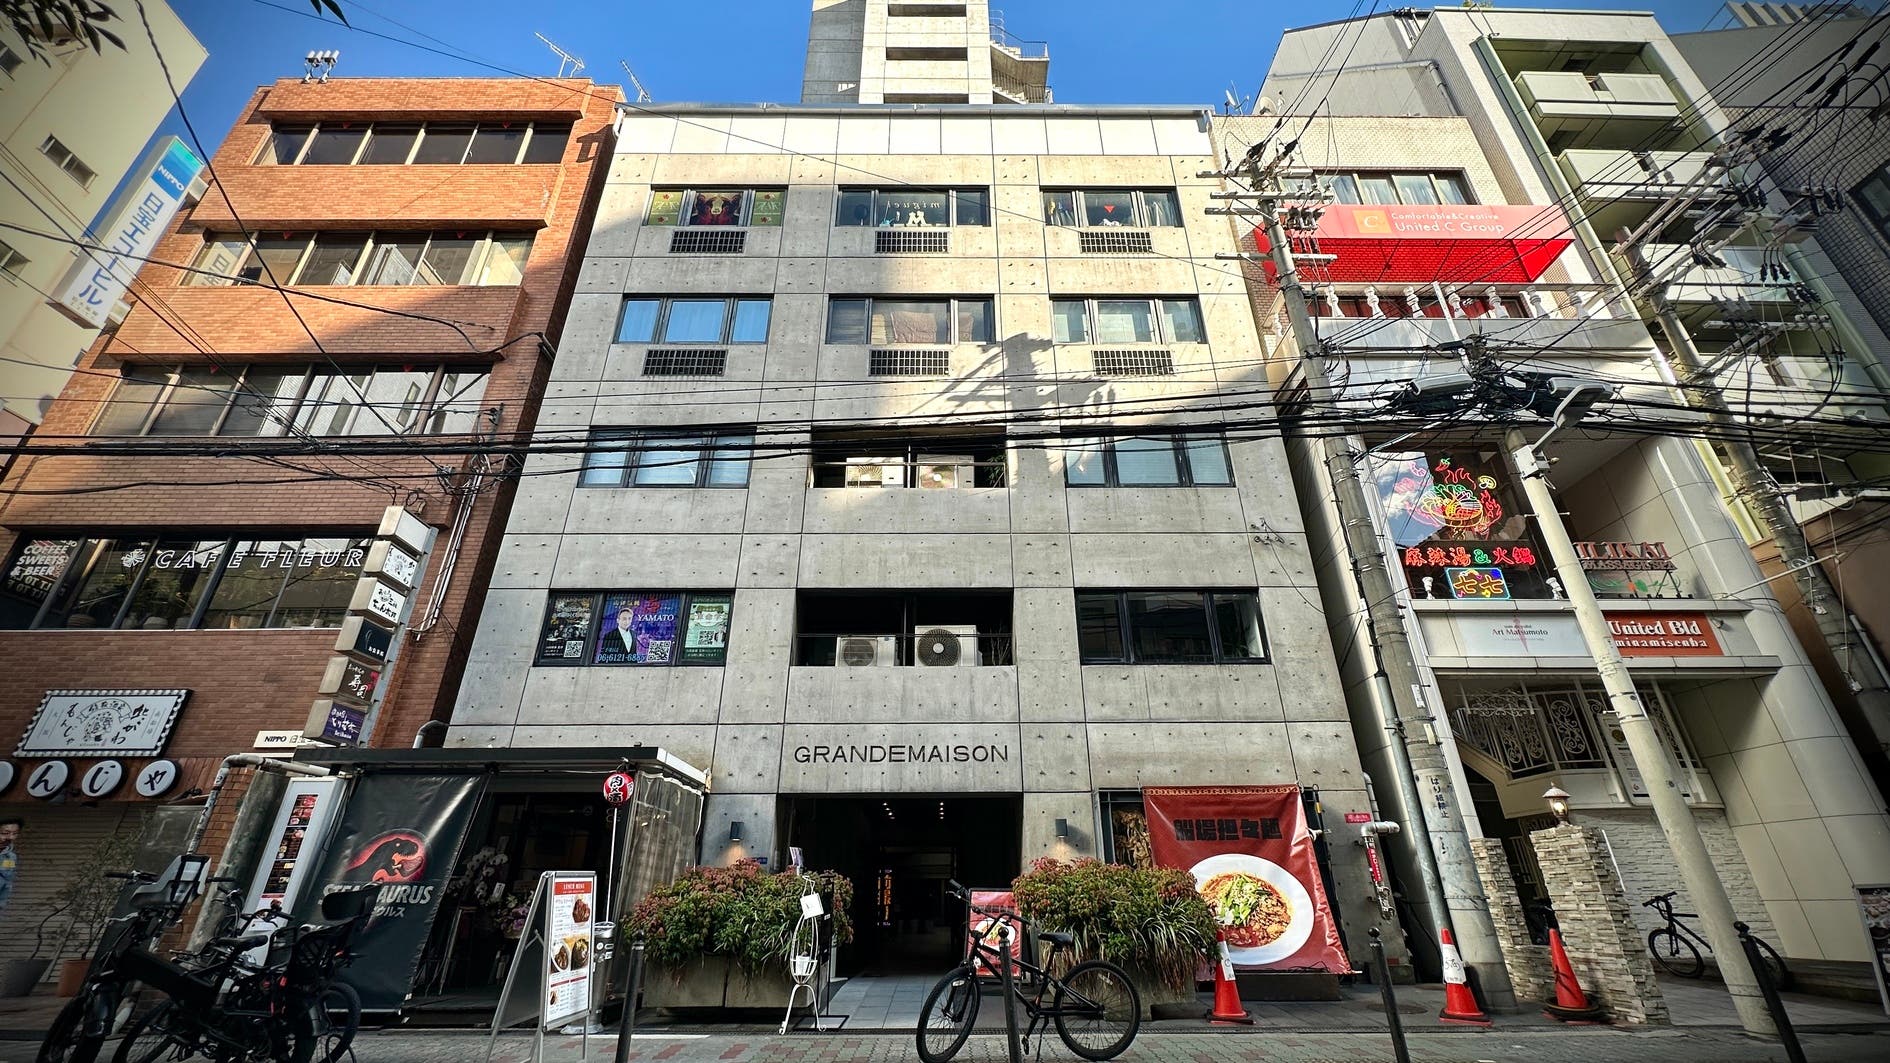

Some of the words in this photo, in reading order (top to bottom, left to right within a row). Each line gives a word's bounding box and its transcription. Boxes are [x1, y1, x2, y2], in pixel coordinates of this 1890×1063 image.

[158, 165, 185, 192] NIPPO
[1460, 222, 1505, 234] Group
[24, 545, 69, 555] COFFEE
[16, 555, 66, 565] SWEETS
[155, 550, 248, 568] CAFE
[260, 549, 364, 568] FLEUR
[24, 566, 55, 576] BEER
[638, 614, 674, 622] YAMATO
[1607, 620, 1666, 635] United
[1667, 620, 1703, 635] Bld
[1615, 637, 1708, 647] minamisenba
[794, 745, 1008, 763] GRANDEMAISON
